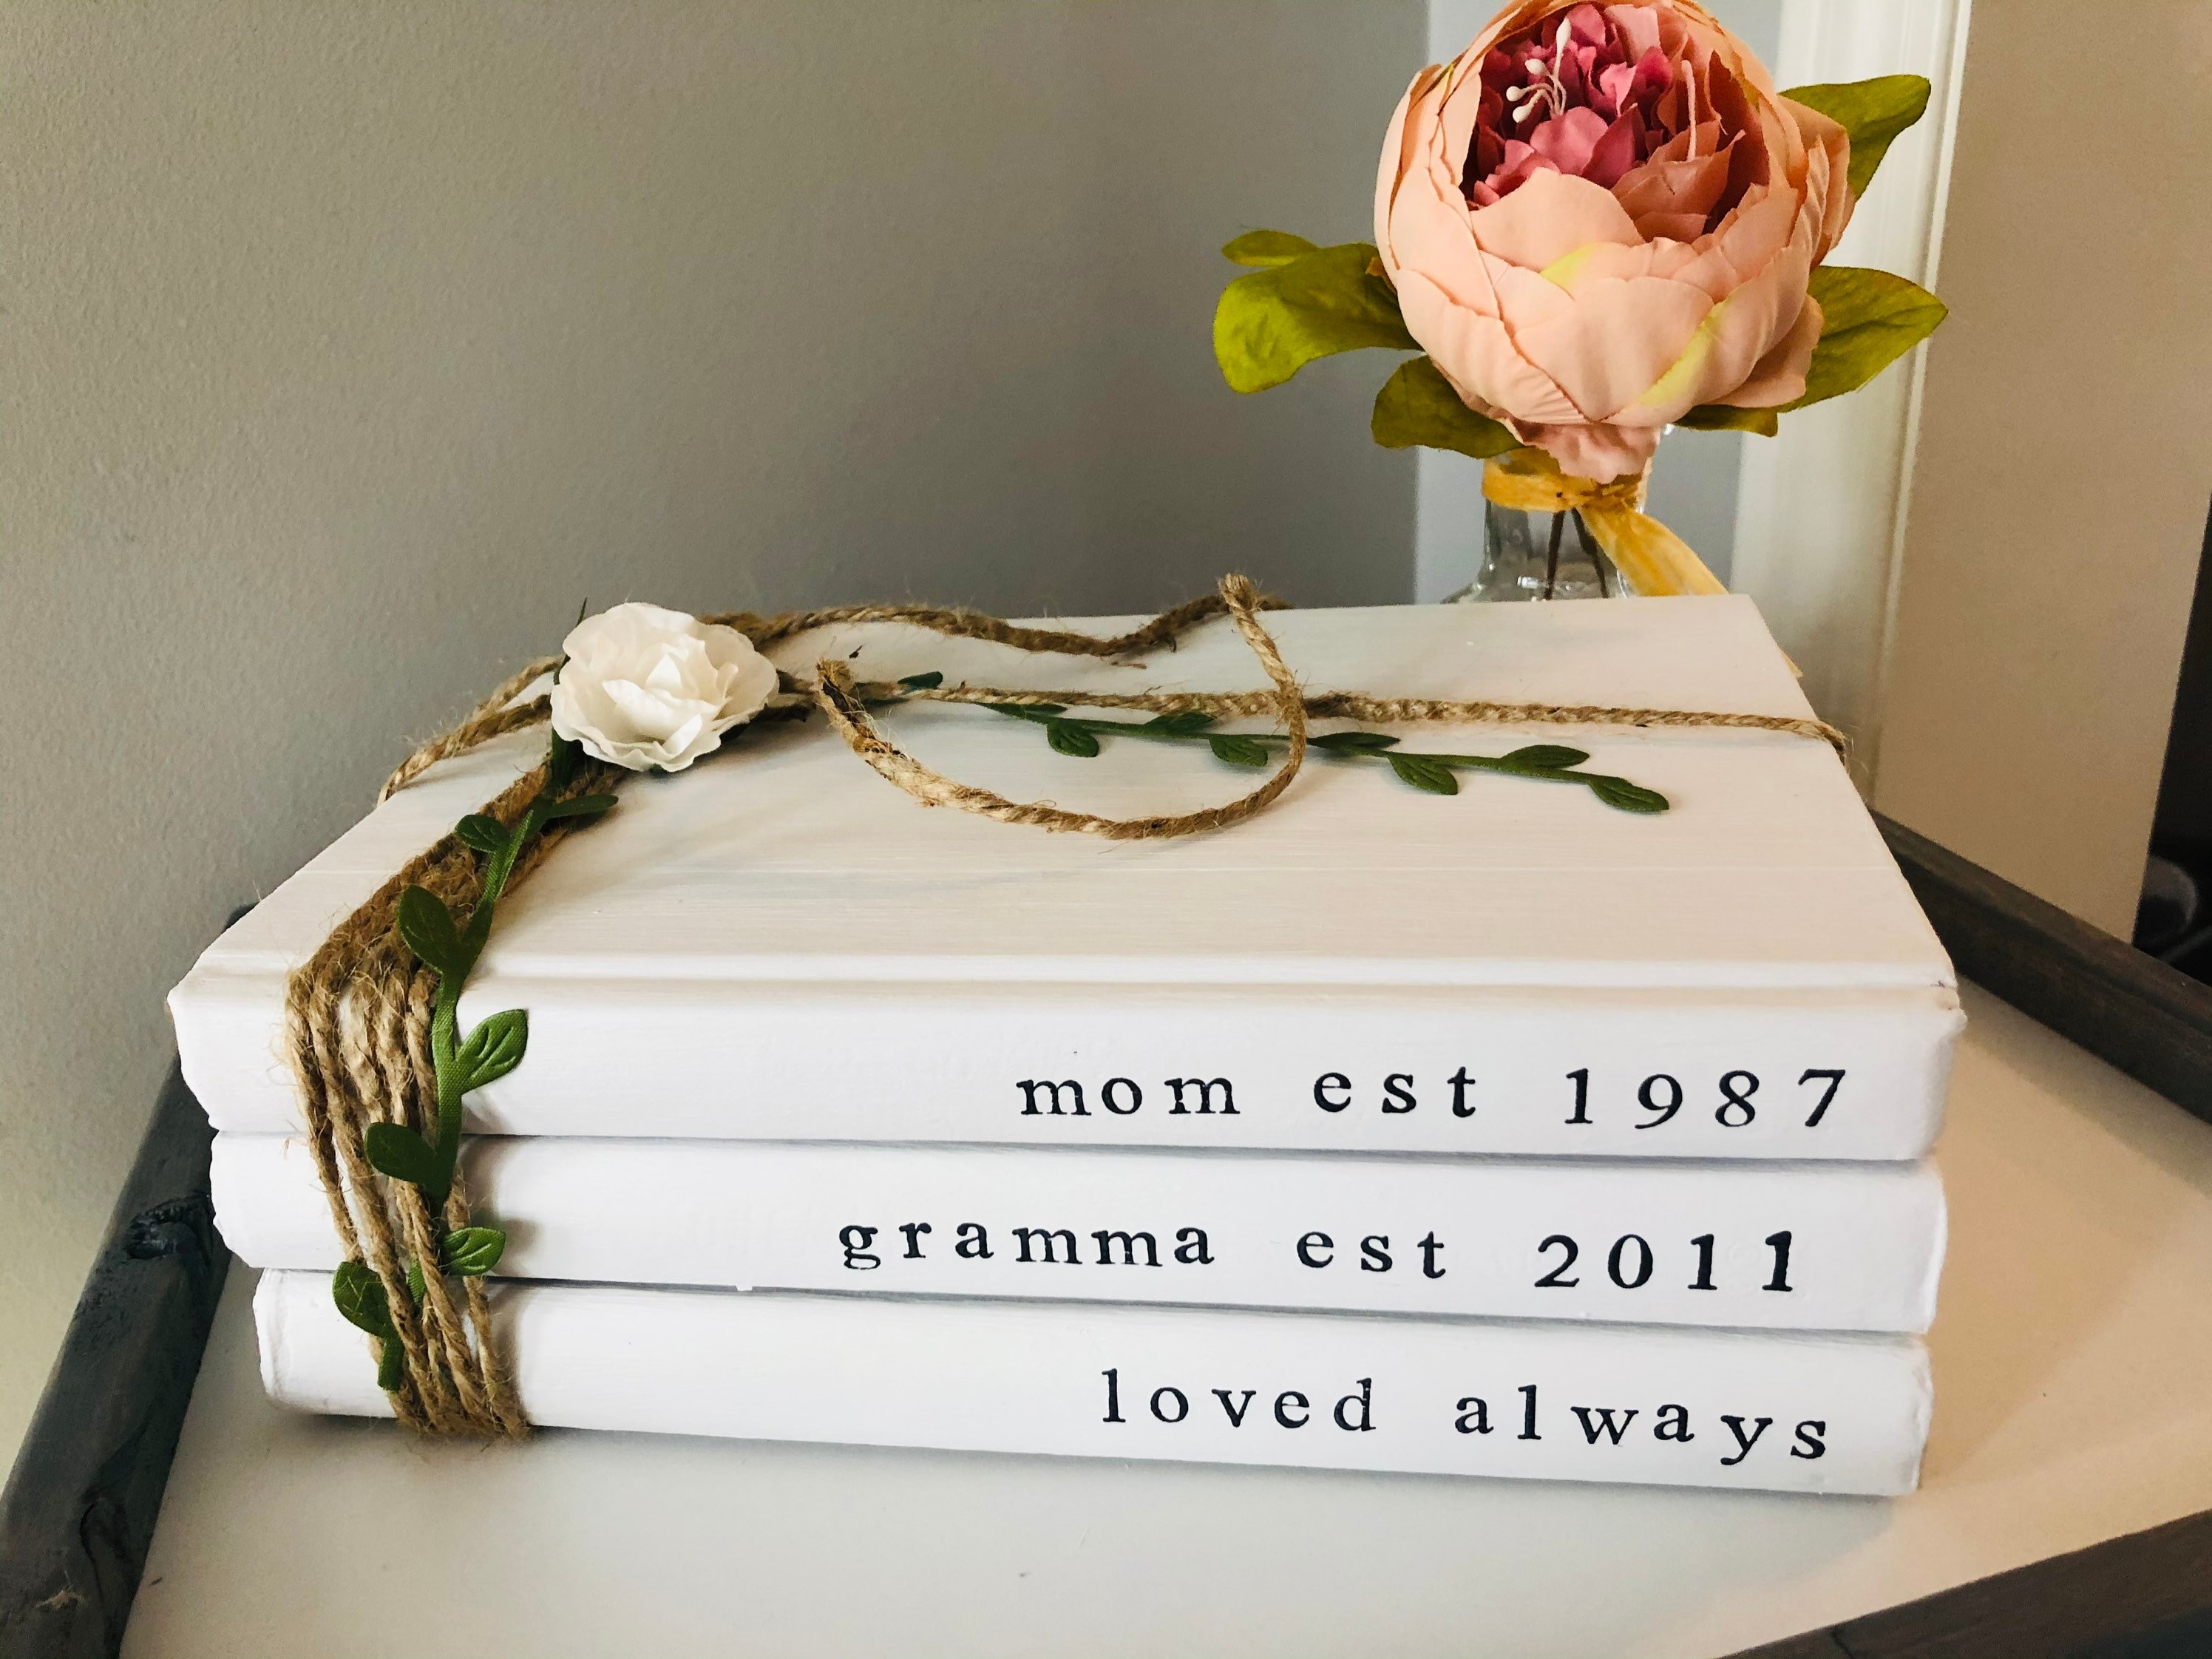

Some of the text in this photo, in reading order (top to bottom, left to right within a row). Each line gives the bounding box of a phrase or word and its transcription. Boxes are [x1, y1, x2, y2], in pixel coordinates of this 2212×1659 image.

[1016, 1066, 1846, 1130] mom est 1987
[838, 1222, 1794, 1292] gramma est 2011
[1102, 1368, 1826, 1466] loved always
